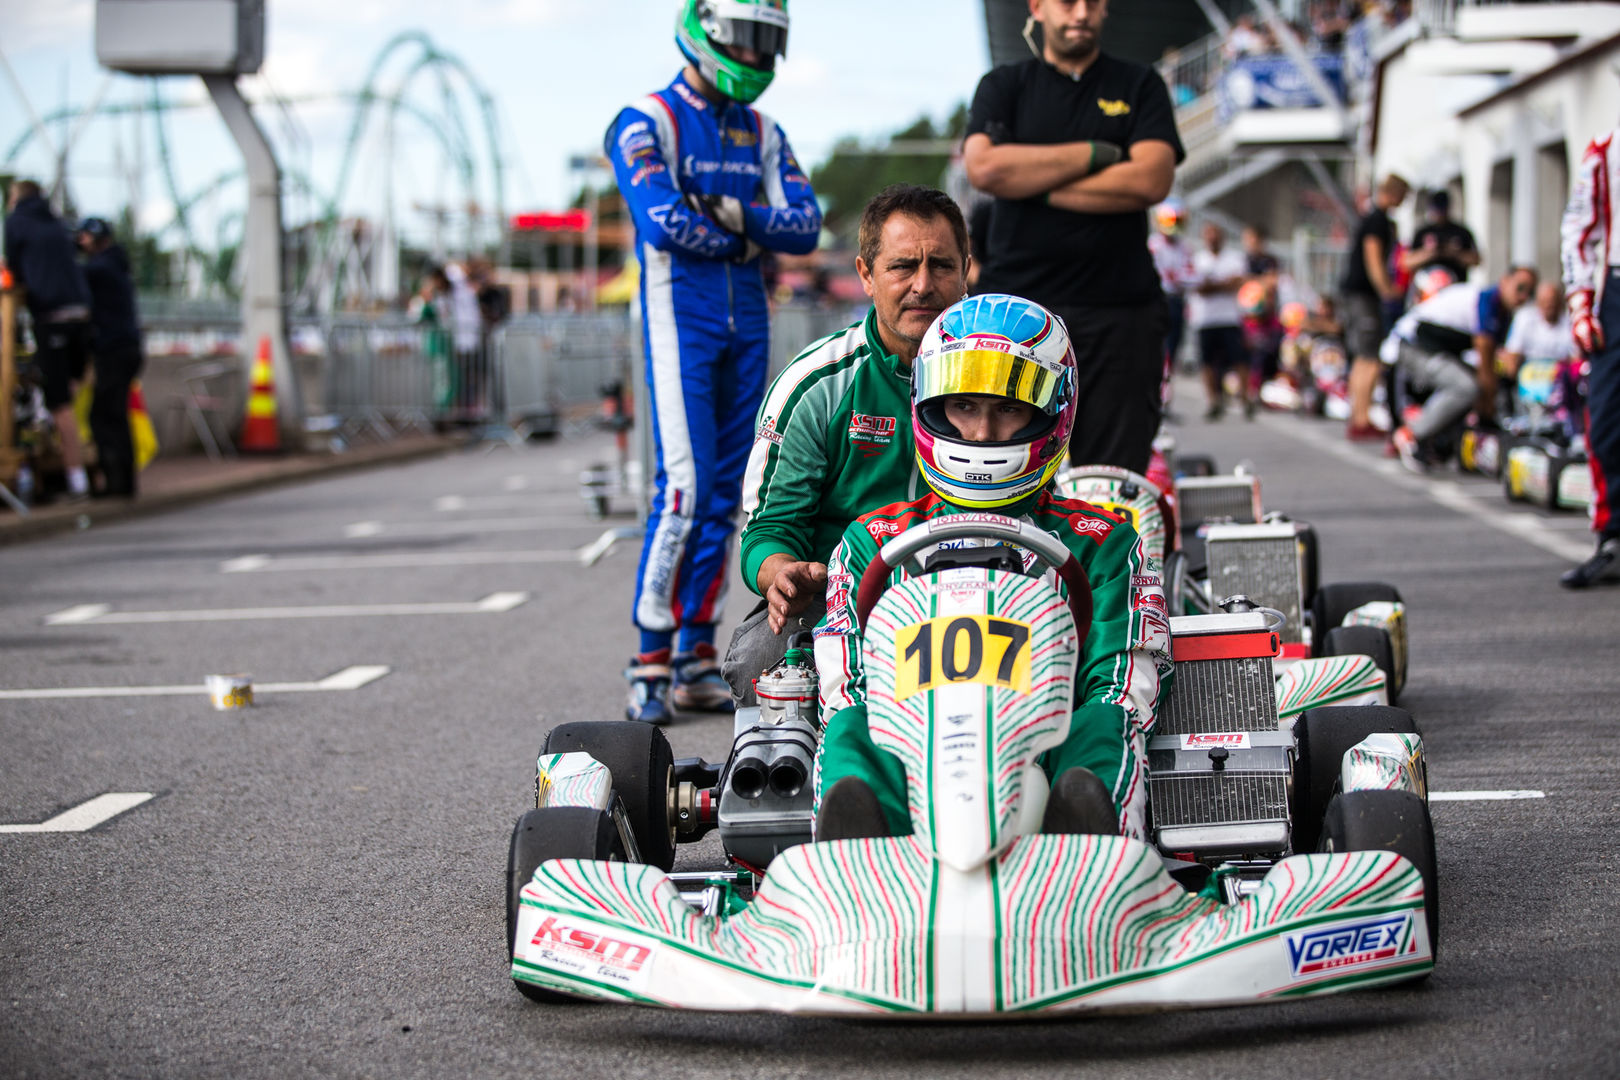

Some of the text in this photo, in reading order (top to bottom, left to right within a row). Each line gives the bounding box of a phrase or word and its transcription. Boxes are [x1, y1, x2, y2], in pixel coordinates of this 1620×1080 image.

[965, 474, 991, 482] OTK
[869, 522, 899, 536] OMP
[1077, 520, 1108, 530] OMP
[905, 617, 1029, 689] 107
[1288, 916, 1406, 973] VORTEX
